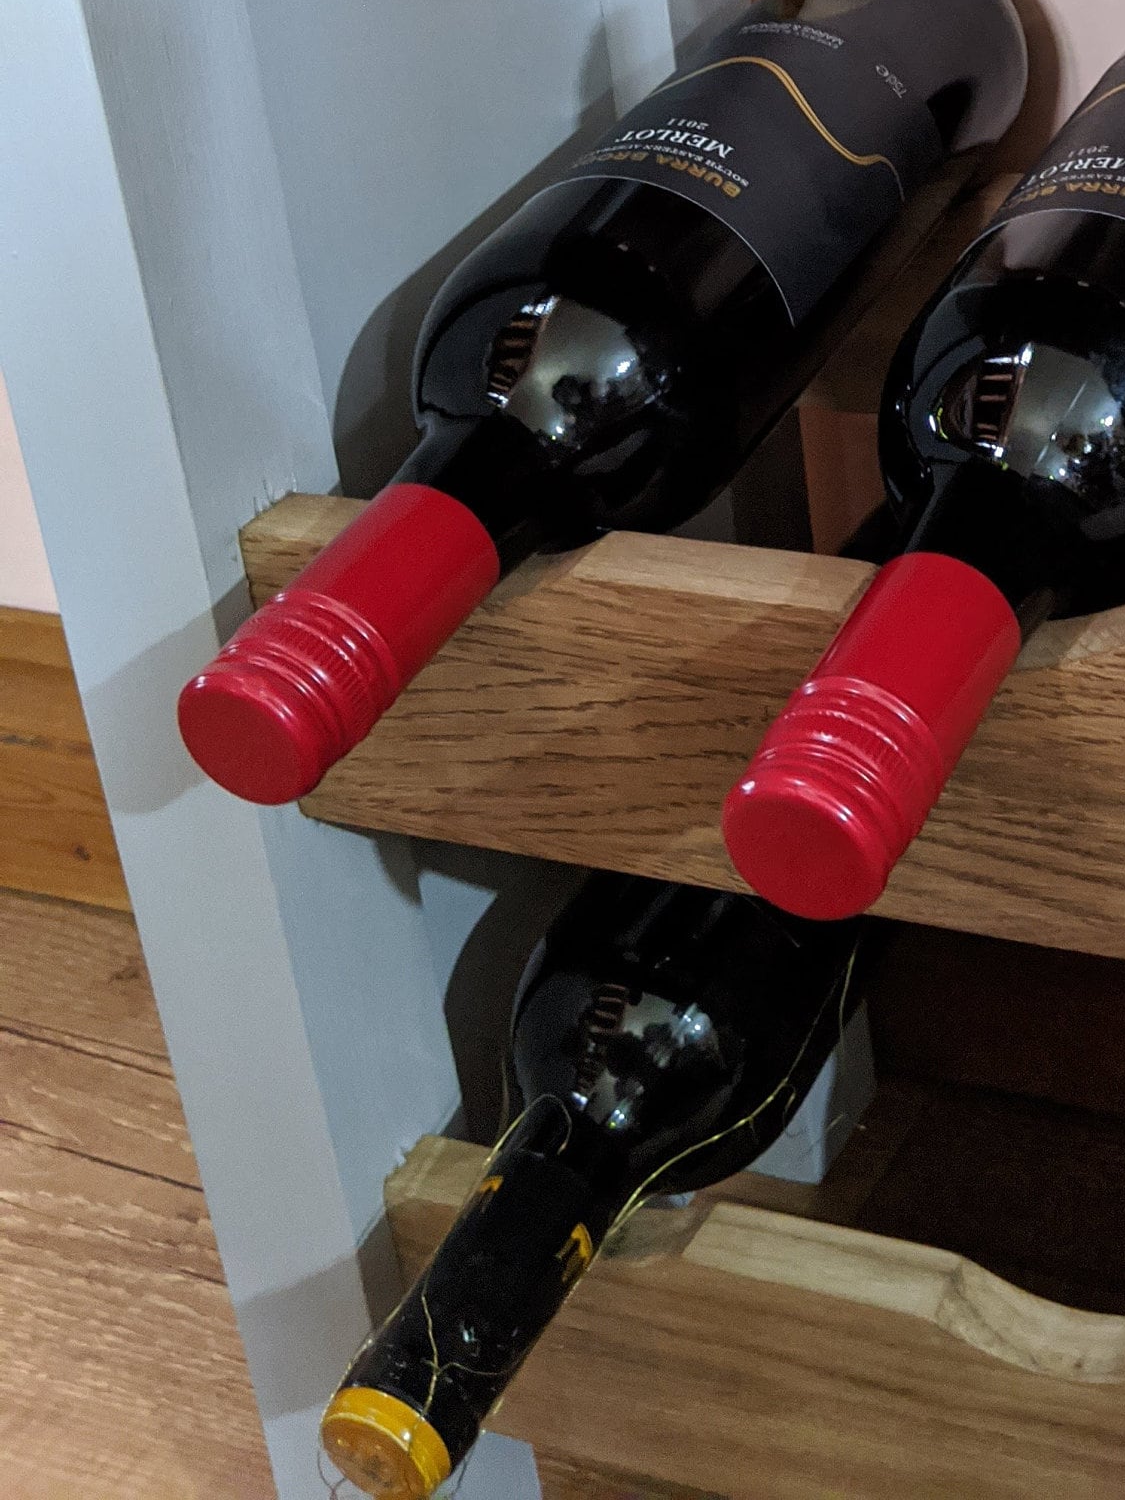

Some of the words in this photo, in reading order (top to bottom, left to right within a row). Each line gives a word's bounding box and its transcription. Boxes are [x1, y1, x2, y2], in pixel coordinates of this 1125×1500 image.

[667, 117, 709, 131] 2011
[615, 128, 735, 159] MERLOT
[646, 143, 704, 162] EASTERN
[1067, 145, 1110, 159] 2011
[656, 153, 742, 198] BURRA
[705, 158, 749, 187] SOUTH
